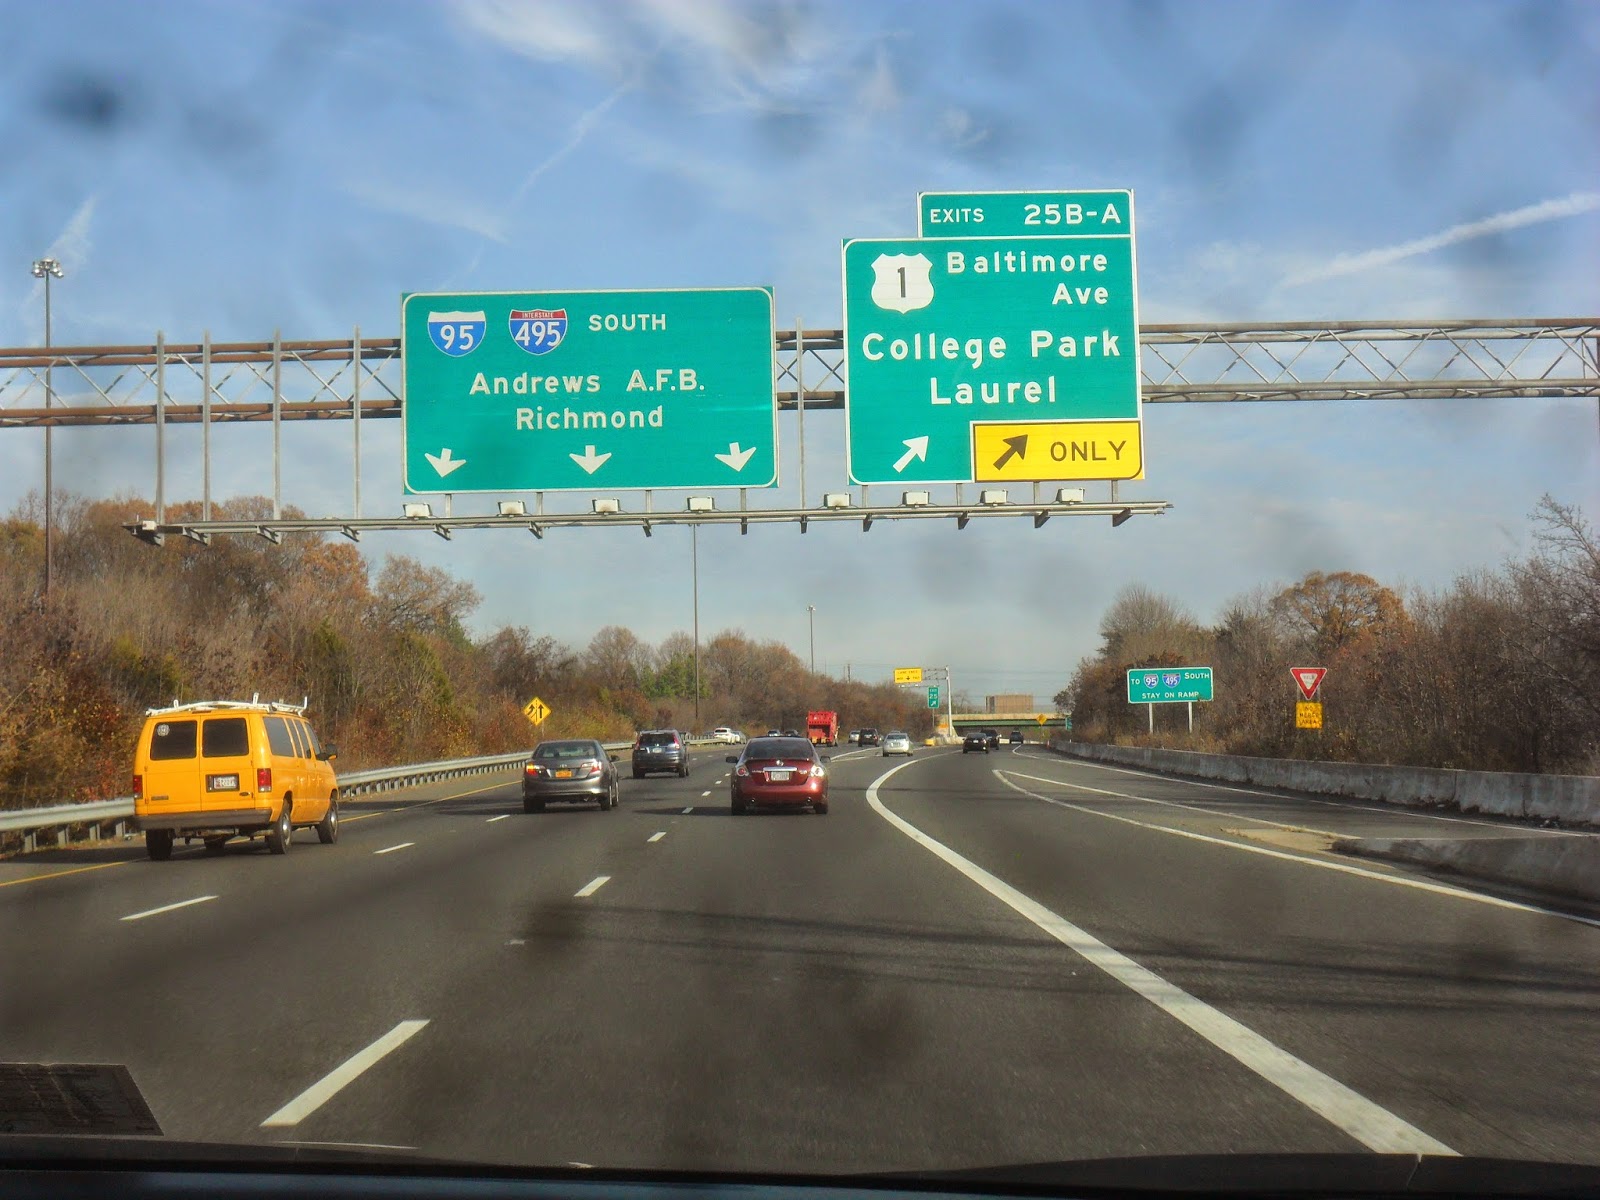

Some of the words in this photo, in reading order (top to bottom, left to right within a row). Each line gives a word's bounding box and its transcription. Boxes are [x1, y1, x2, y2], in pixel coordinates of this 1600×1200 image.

[930, 208, 985, 223] EXITS
[1024, 203, 1121, 225] 25B-A
[947, 250, 1108, 274] Baltimore
[897, 266, 906, 298] 1
[1051, 283, 1109, 305] Ave
[522, 311, 554, 319] INTERSTATE
[588, 313, 667, 331] SOUTH
[440, 324, 474, 351] 95
[515, 321, 561, 347] 495
[862, 332, 1007, 369] College
[1031, 330, 1121, 358] Park
[469, 371, 601, 396] Andrews
[626, 368, 705, 392] A.F.B.
[930, 376, 1056, 405] Laurel
[516, 405, 664, 430] Richmond
[1050, 440, 1127, 462] ONLY
[1145, 677, 1157, 686] 95
[1165, 676, 1178, 685] 495
[1184, 672, 1210, 680] SOUTH
